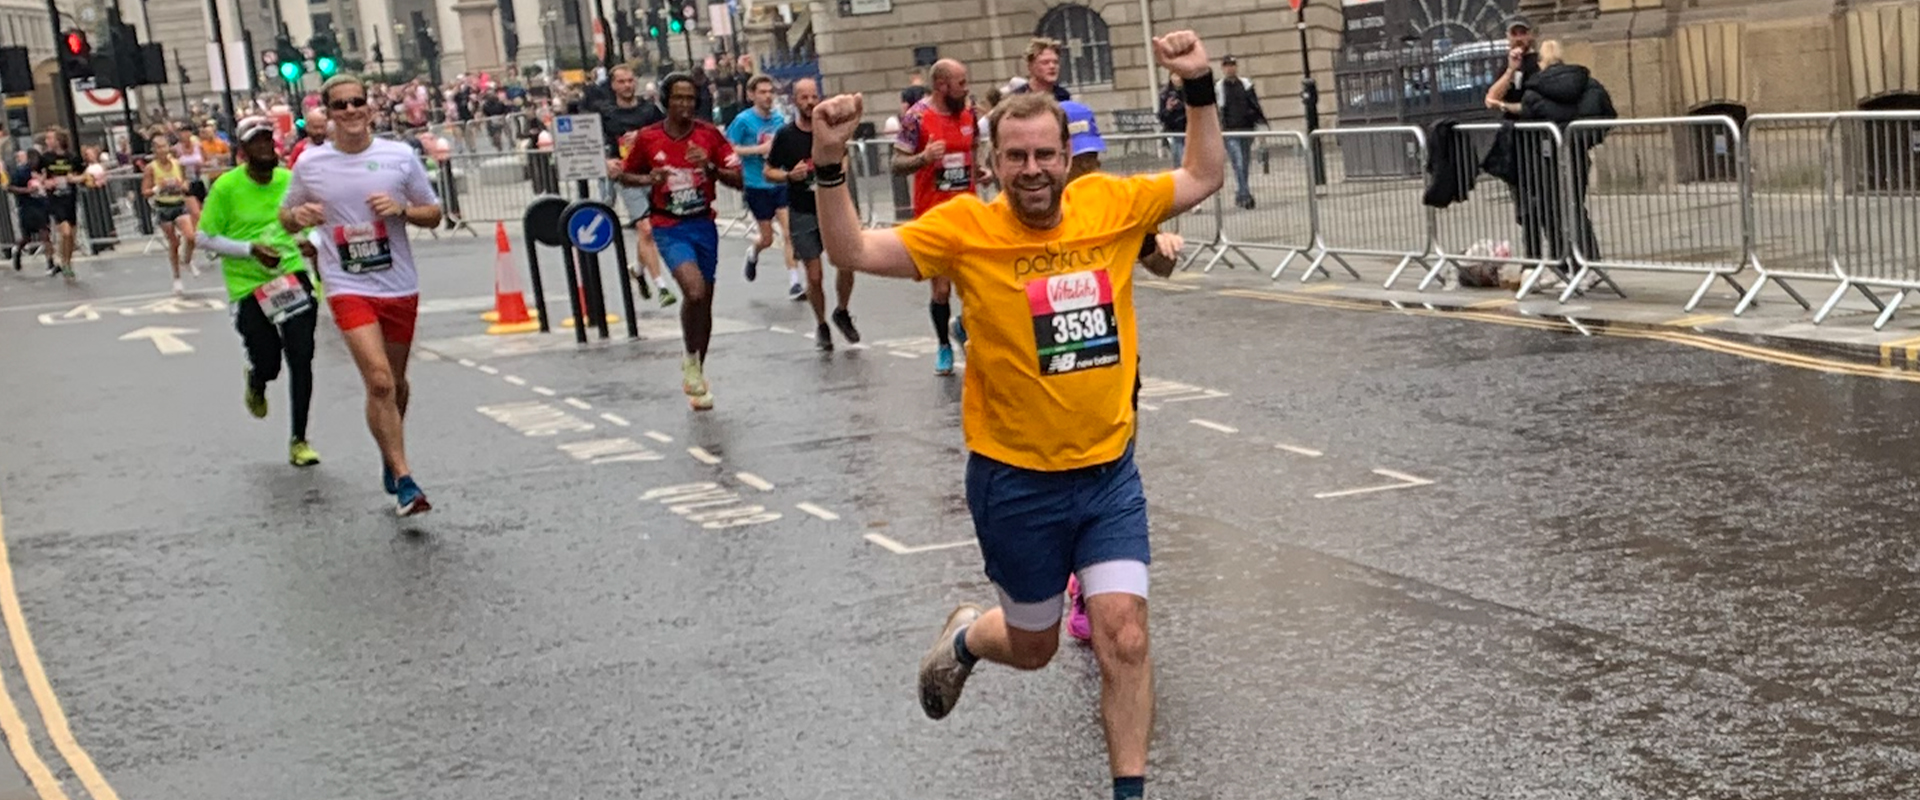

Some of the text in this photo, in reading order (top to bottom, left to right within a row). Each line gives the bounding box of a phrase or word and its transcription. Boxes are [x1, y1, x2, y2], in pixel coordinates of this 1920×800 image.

[1015, 242, 1107, 281] parkrun
[1050, 279, 1096, 303] Vitality
[1051, 307, 1107, 344] 3538
